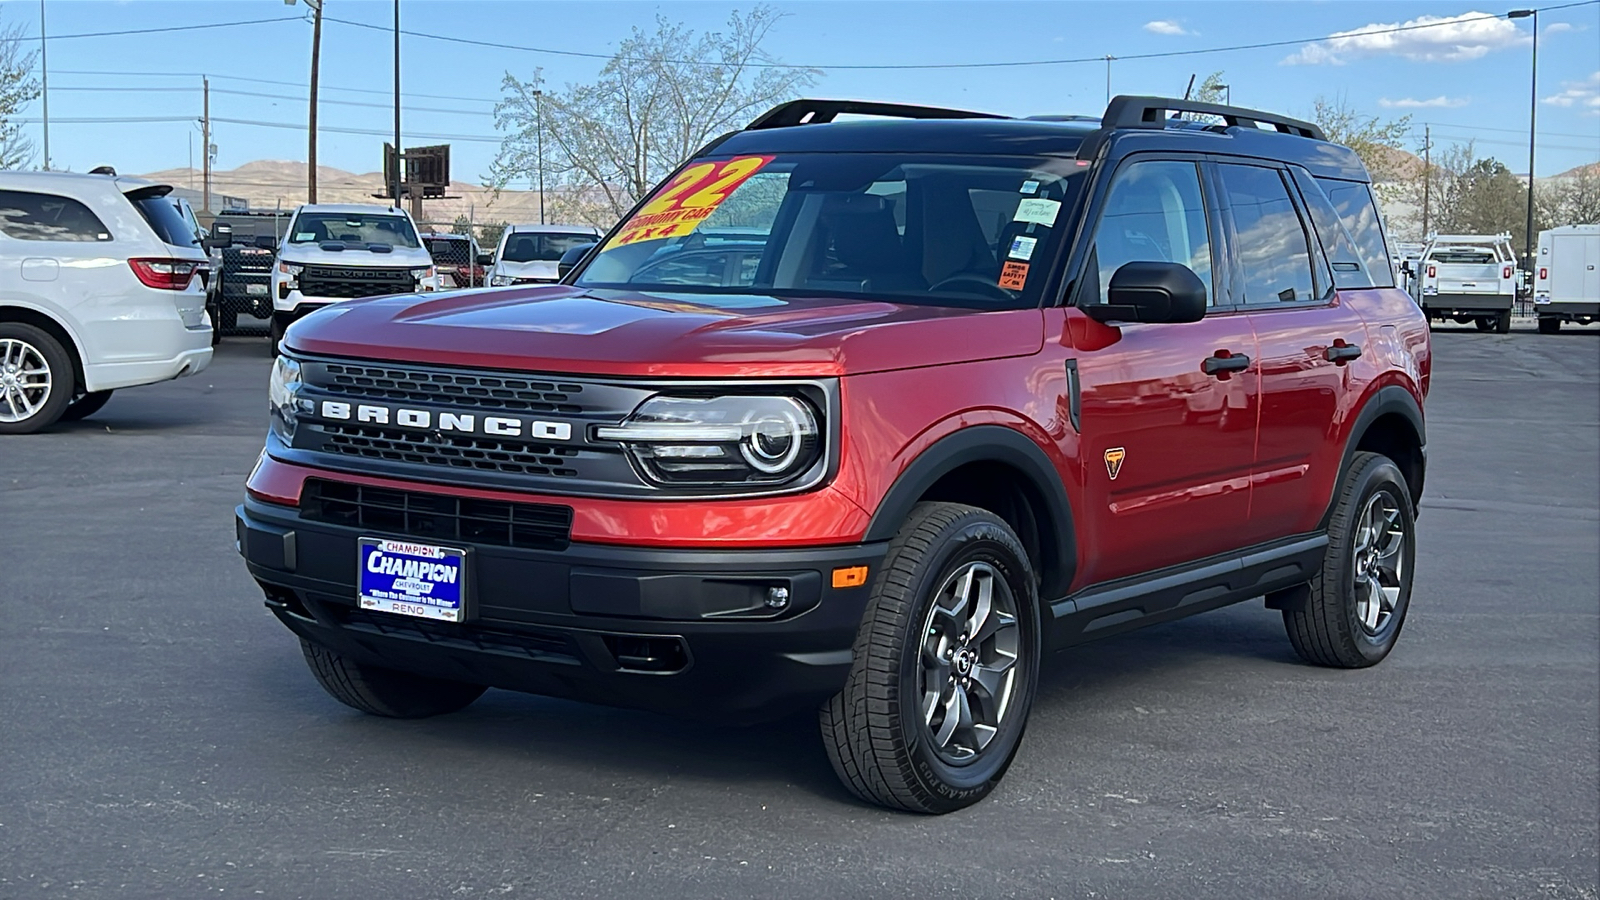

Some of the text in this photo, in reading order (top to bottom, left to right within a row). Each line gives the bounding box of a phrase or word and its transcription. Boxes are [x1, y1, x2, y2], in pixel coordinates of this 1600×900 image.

[638, 157, 764, 216] 22
[682, 207, 714, 221] CAR
[321, 400, 572, 441] BRONCO
[386, 543, 435, 557] CHAMPION
[367, 550, 458, 584] CHAMPION
[395, 581, 431, 592] CHEVROLET
[392, 603, 425, 615] RENO
